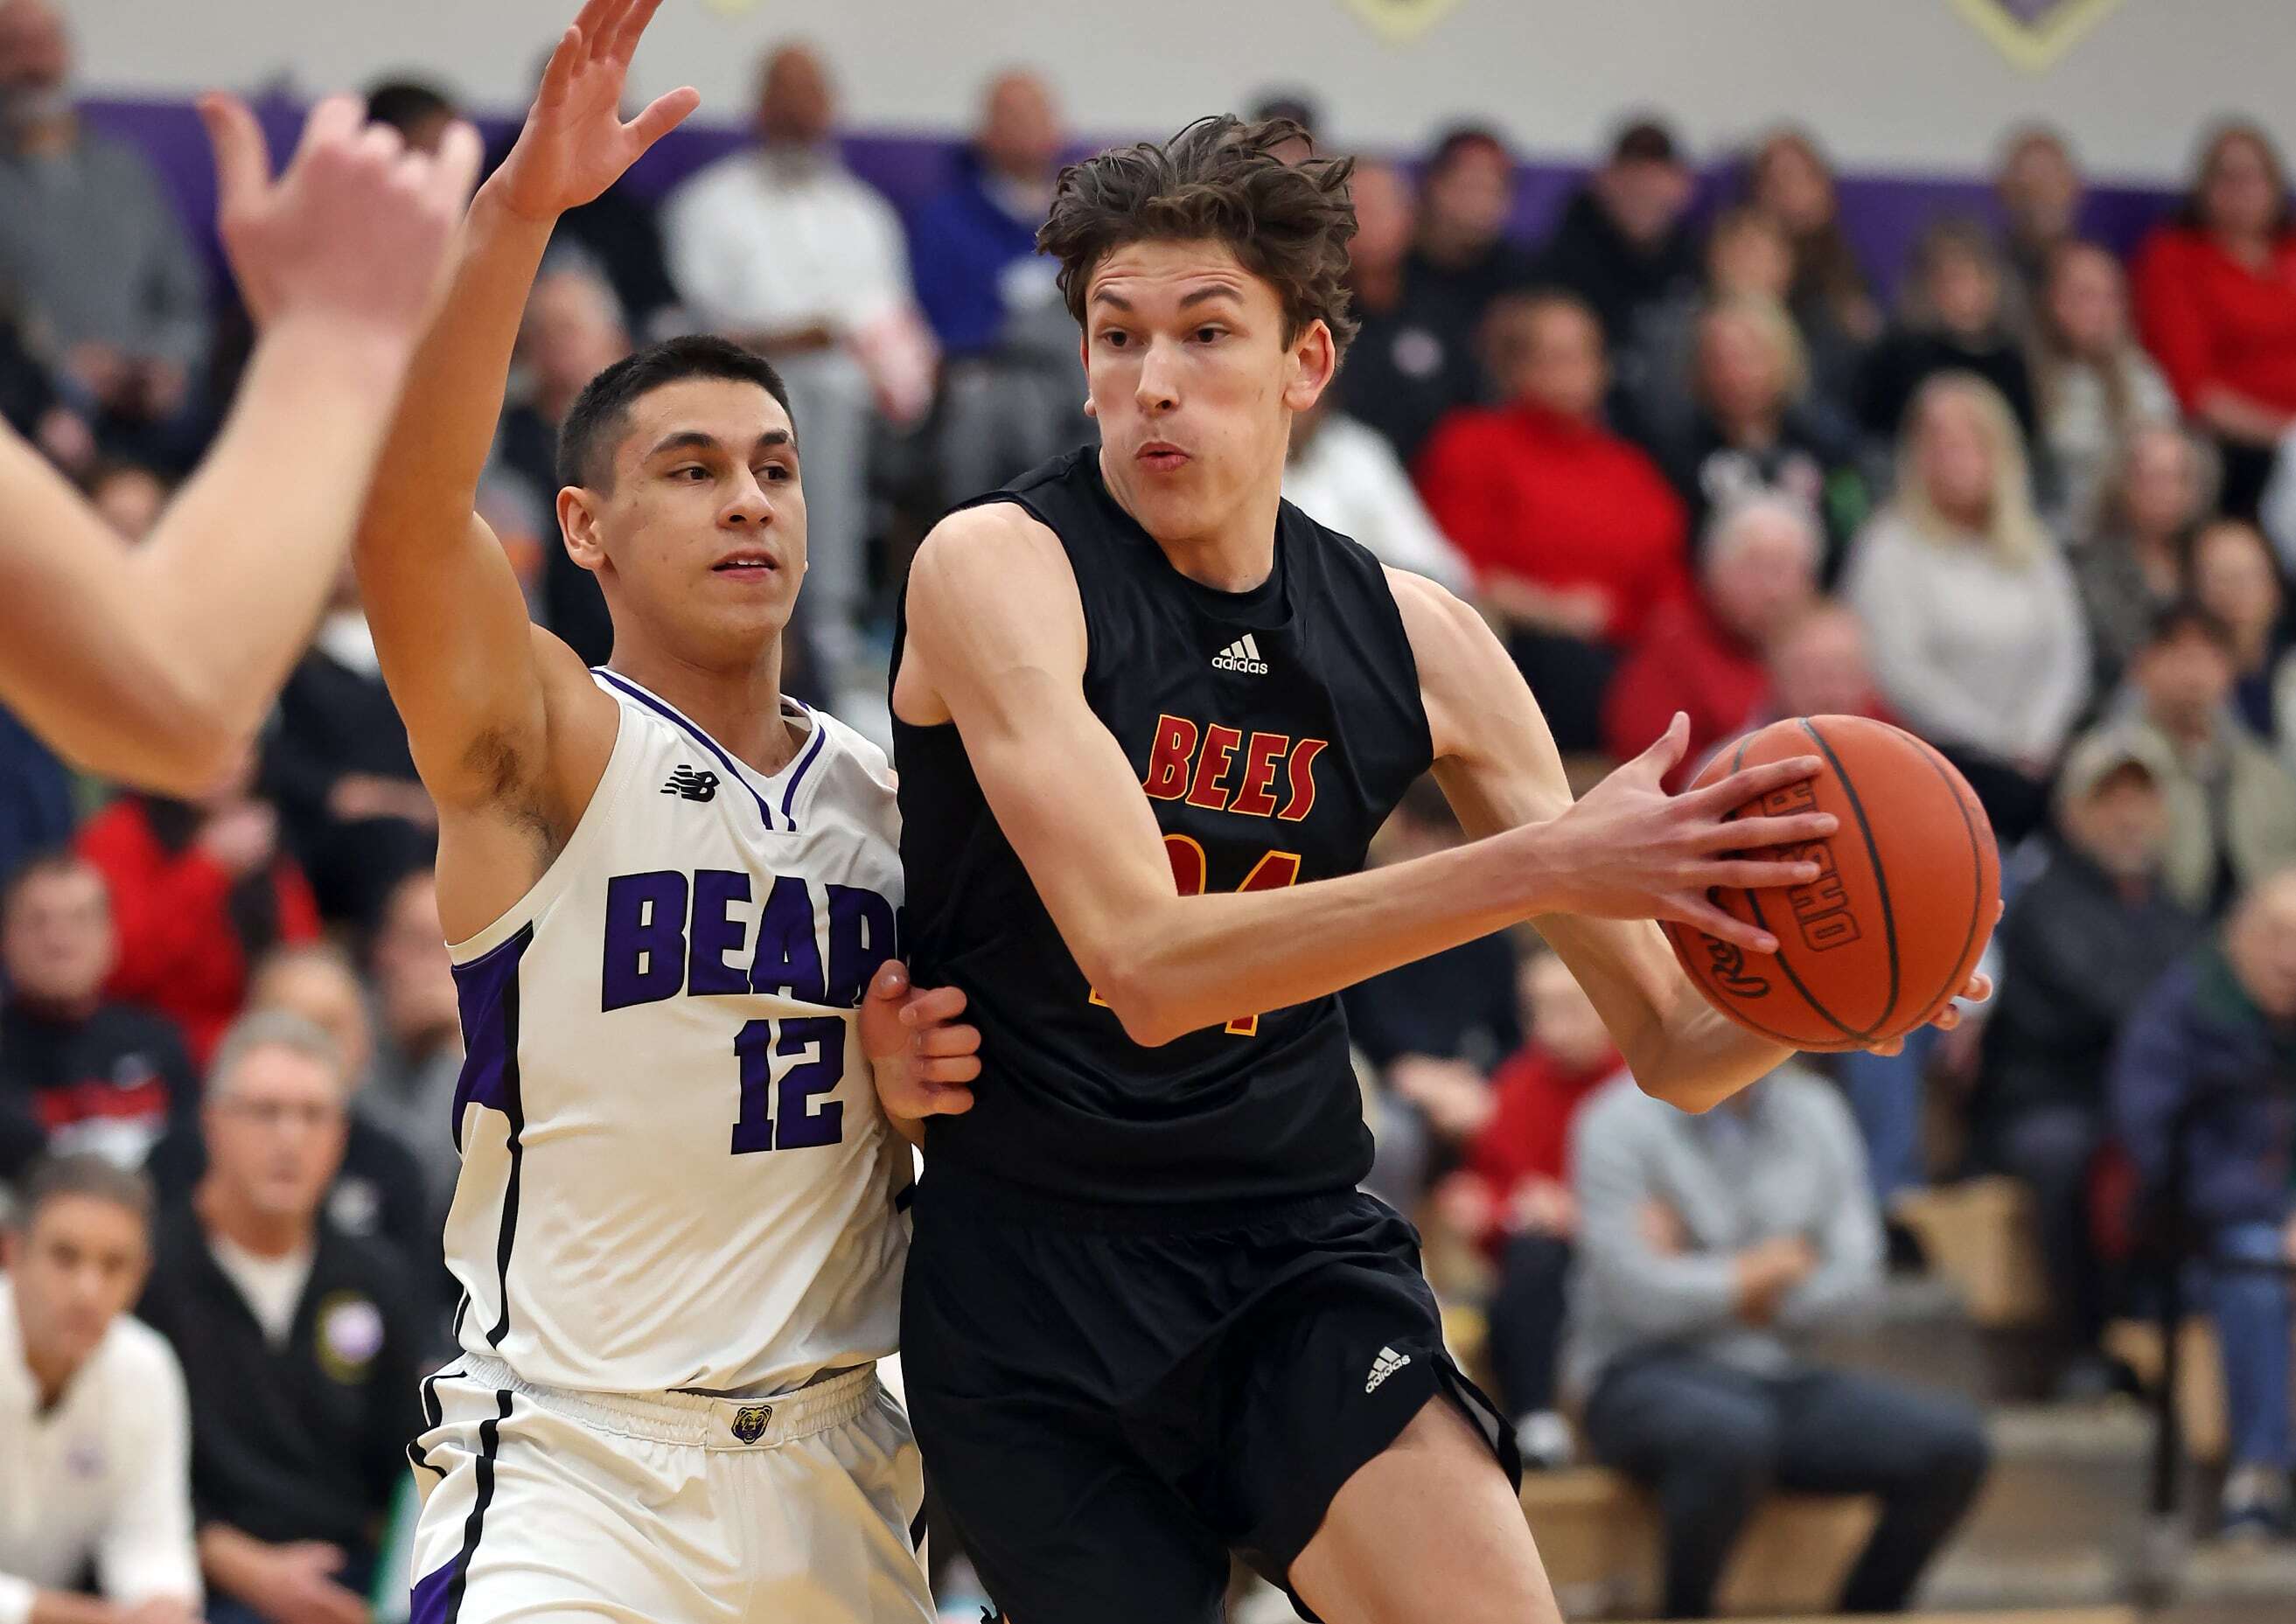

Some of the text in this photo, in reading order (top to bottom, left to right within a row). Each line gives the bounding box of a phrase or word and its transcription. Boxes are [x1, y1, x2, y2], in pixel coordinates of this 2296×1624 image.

[1211, 656, 1268, 674] adidas
[1141, 714, 1328, 822] BEES
[602, 869, 909, 1014] BEAR
[730, 1015, 847, 1155] 12
[1365, 1354, 1411, 1394] adidas
